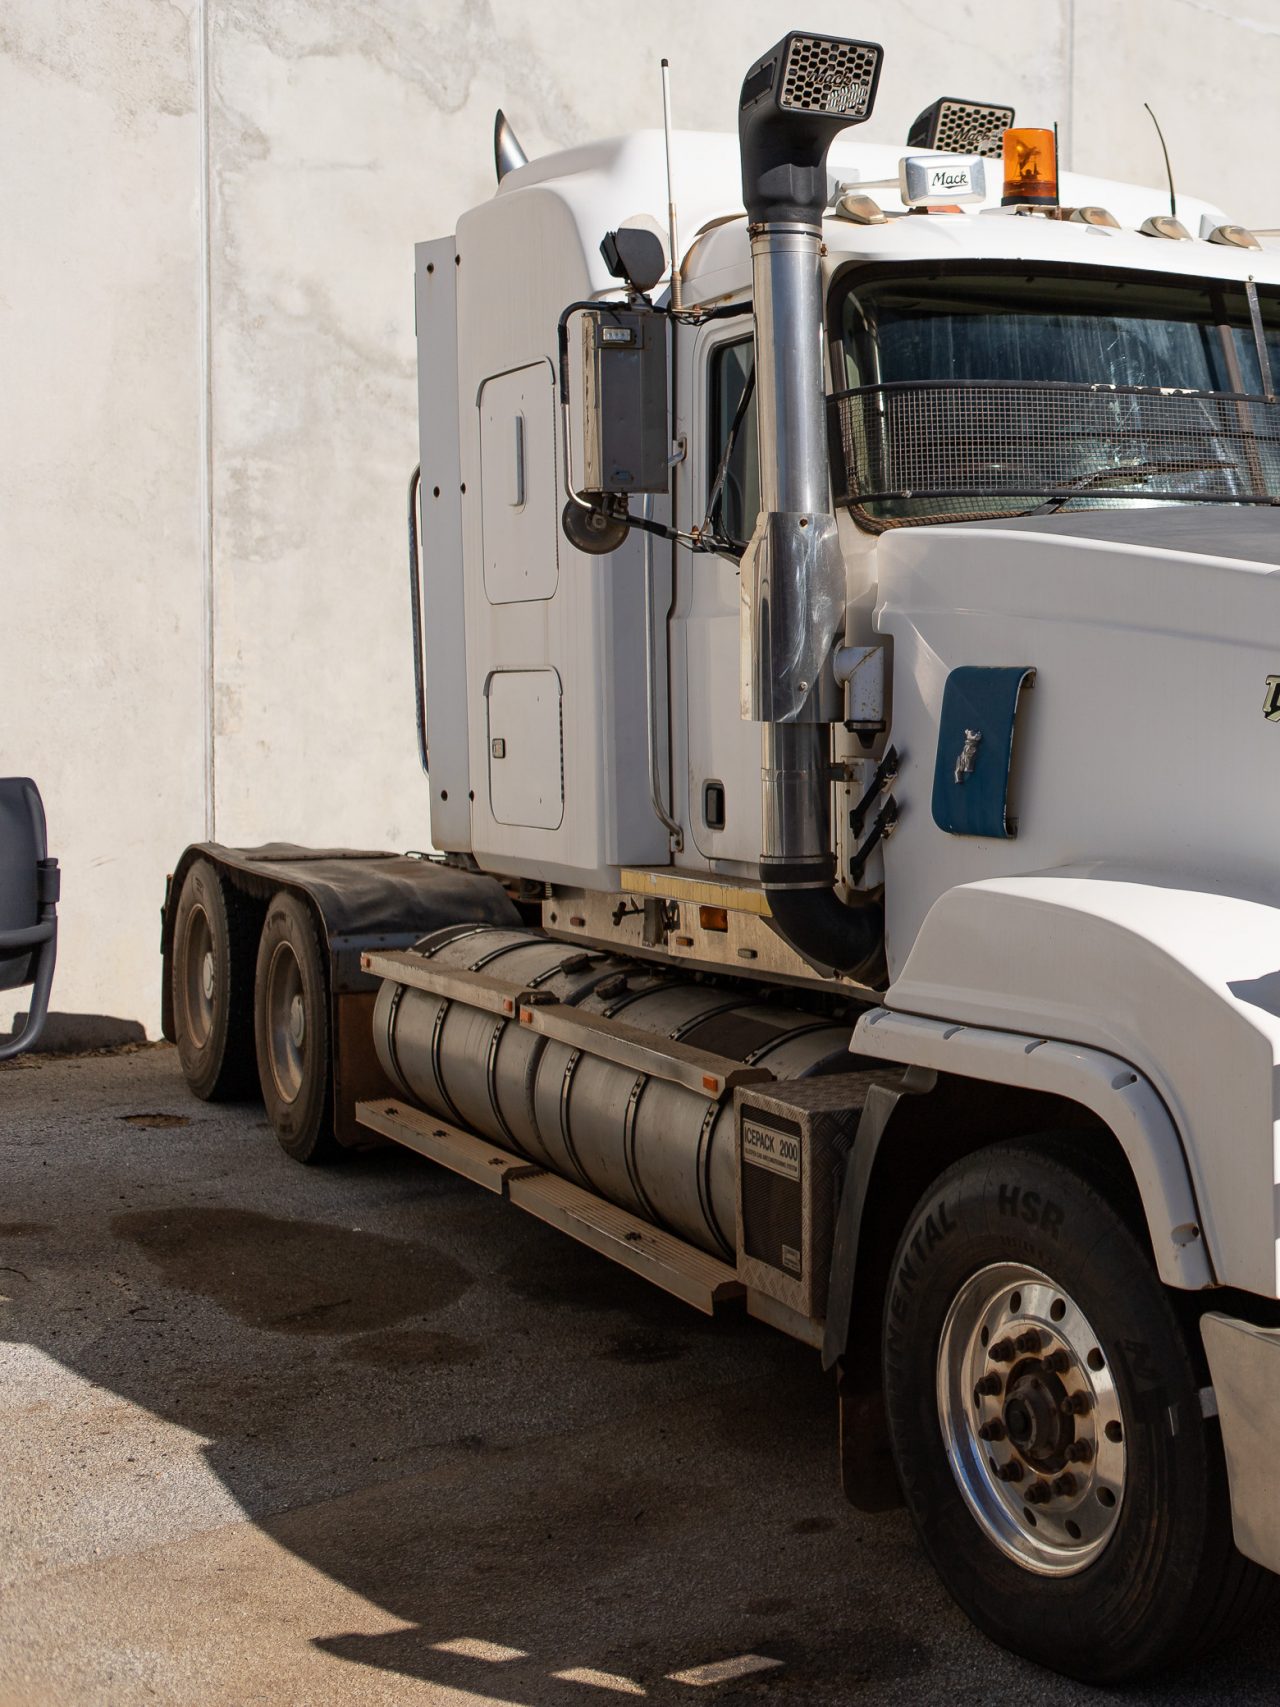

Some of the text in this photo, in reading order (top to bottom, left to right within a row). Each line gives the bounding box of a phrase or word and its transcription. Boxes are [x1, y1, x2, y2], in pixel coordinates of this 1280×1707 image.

[931, 172, 969, 187] Mack
[744, 1125, 798, 1162] ICEPACK 2000
[1000, 1183, 1066, 1243] HSR
